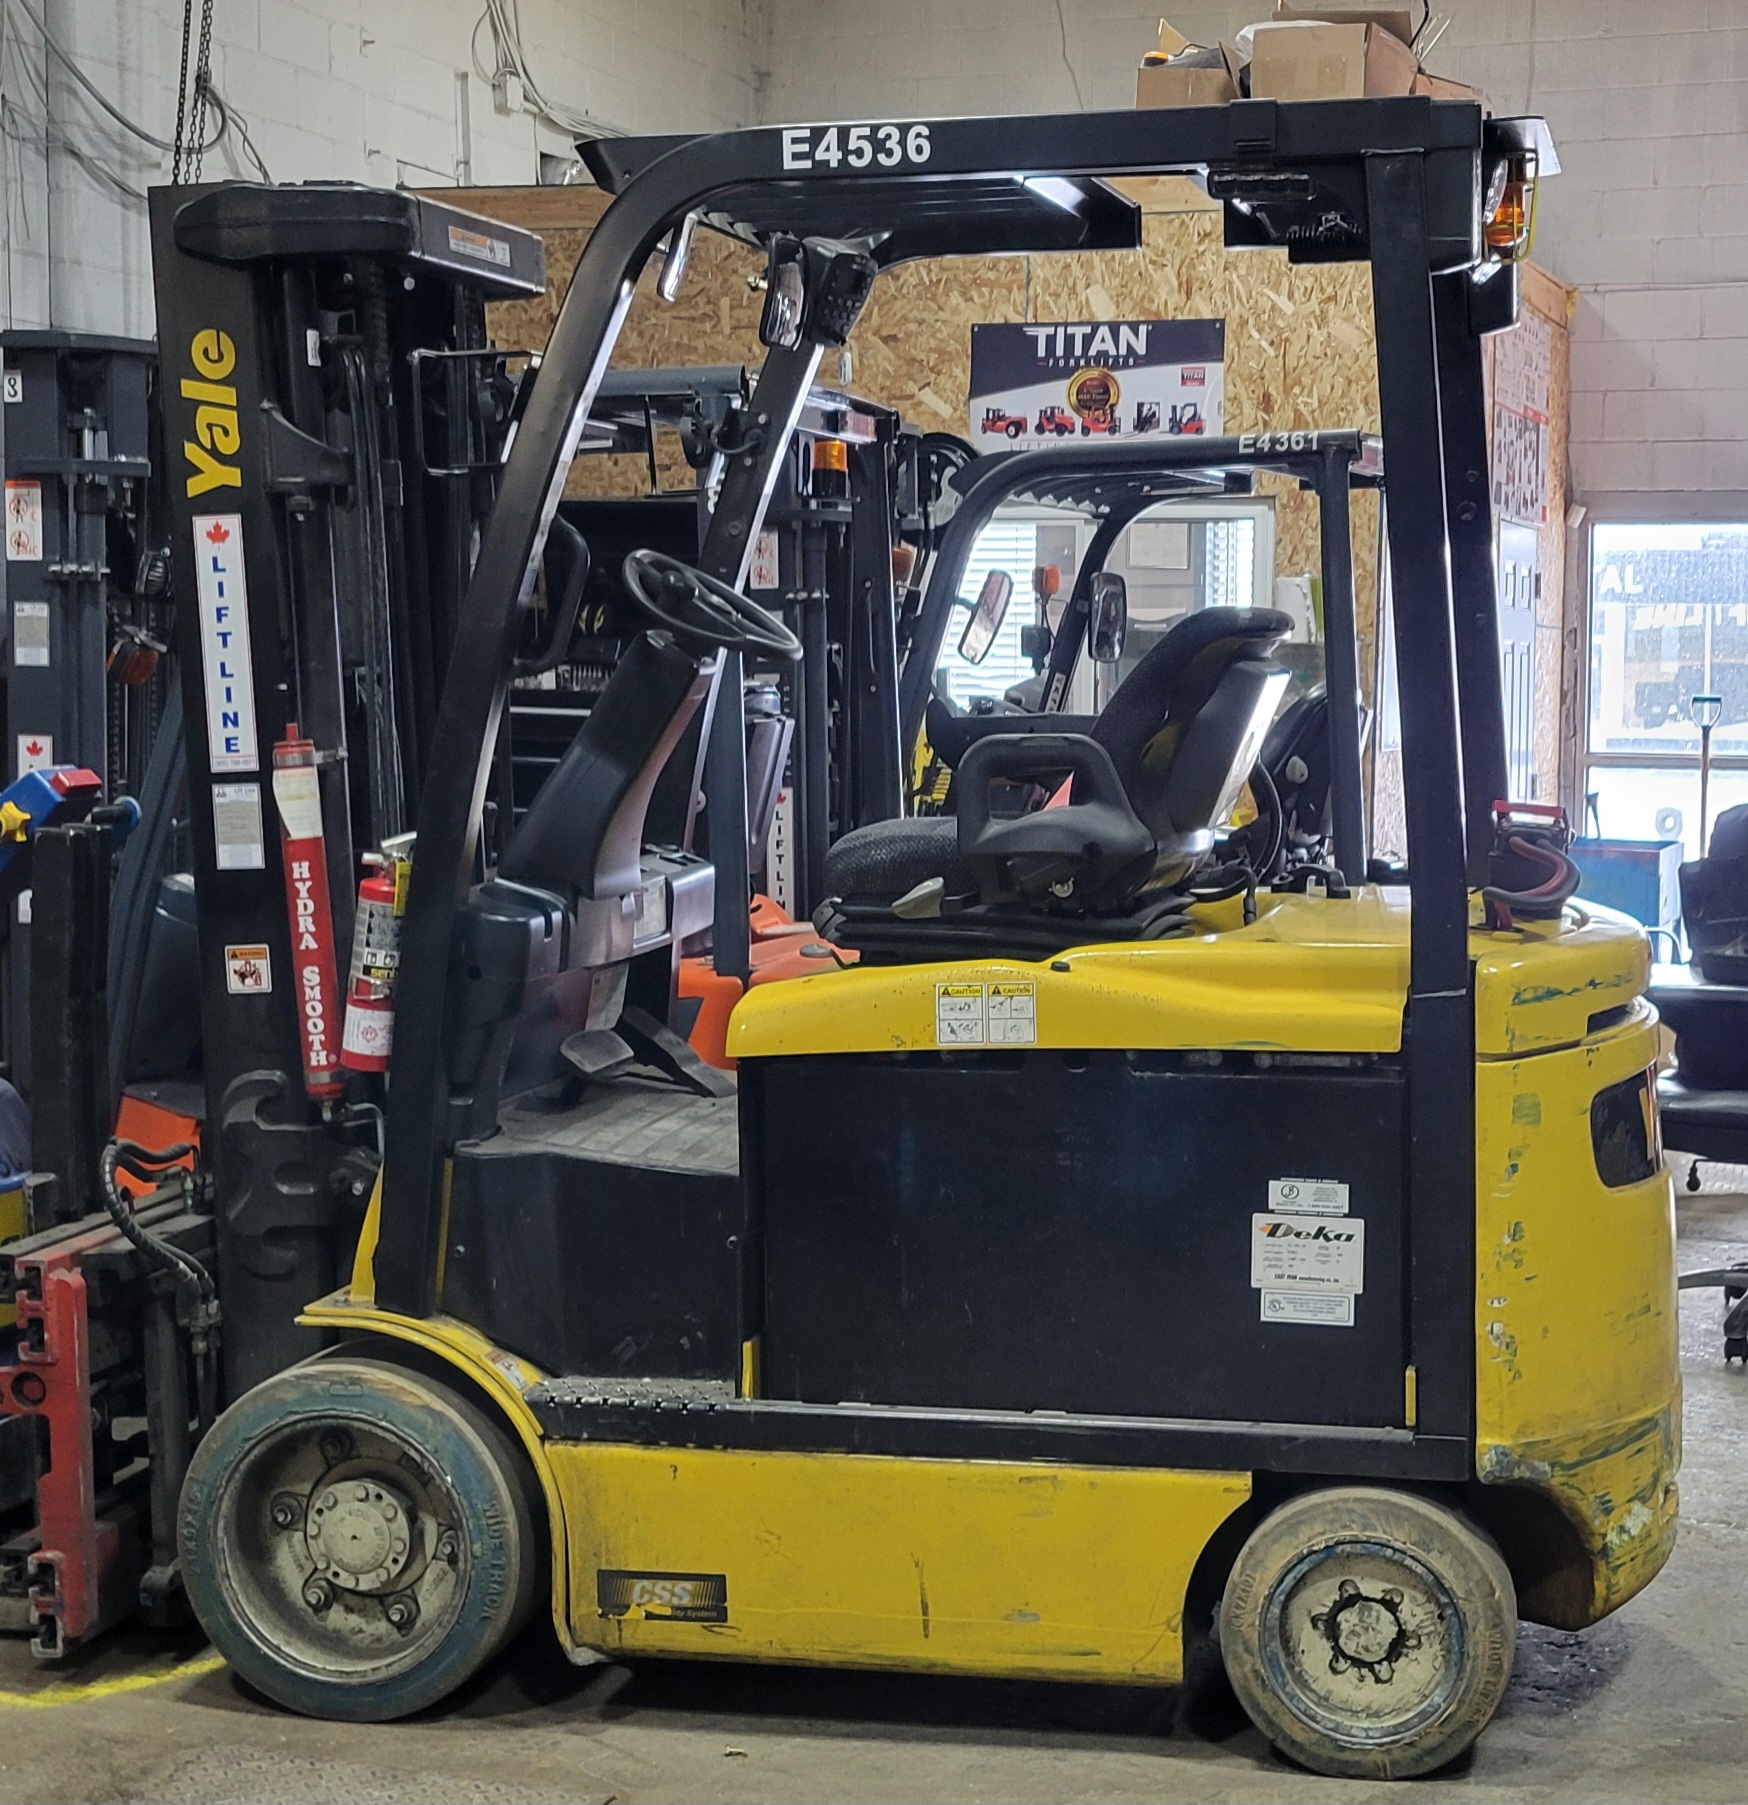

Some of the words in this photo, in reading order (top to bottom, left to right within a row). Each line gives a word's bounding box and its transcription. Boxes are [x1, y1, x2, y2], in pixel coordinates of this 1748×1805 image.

[782, 125, 931, 170] E4536
[1023, 324, 1147, 357] TITAN
[1048, 357, 1134, 367] FORKLIFTS
[181, 329, 242, 498] Yale
[1239, 431, 1319, 454] E4361
[292, 861, 318, 950] HYDRA
[303, 966, 328, 1067] SMOOTH
[1260, 1222, 1356, 1243] Deka
[632, 1580, 693, 1606] CSS
